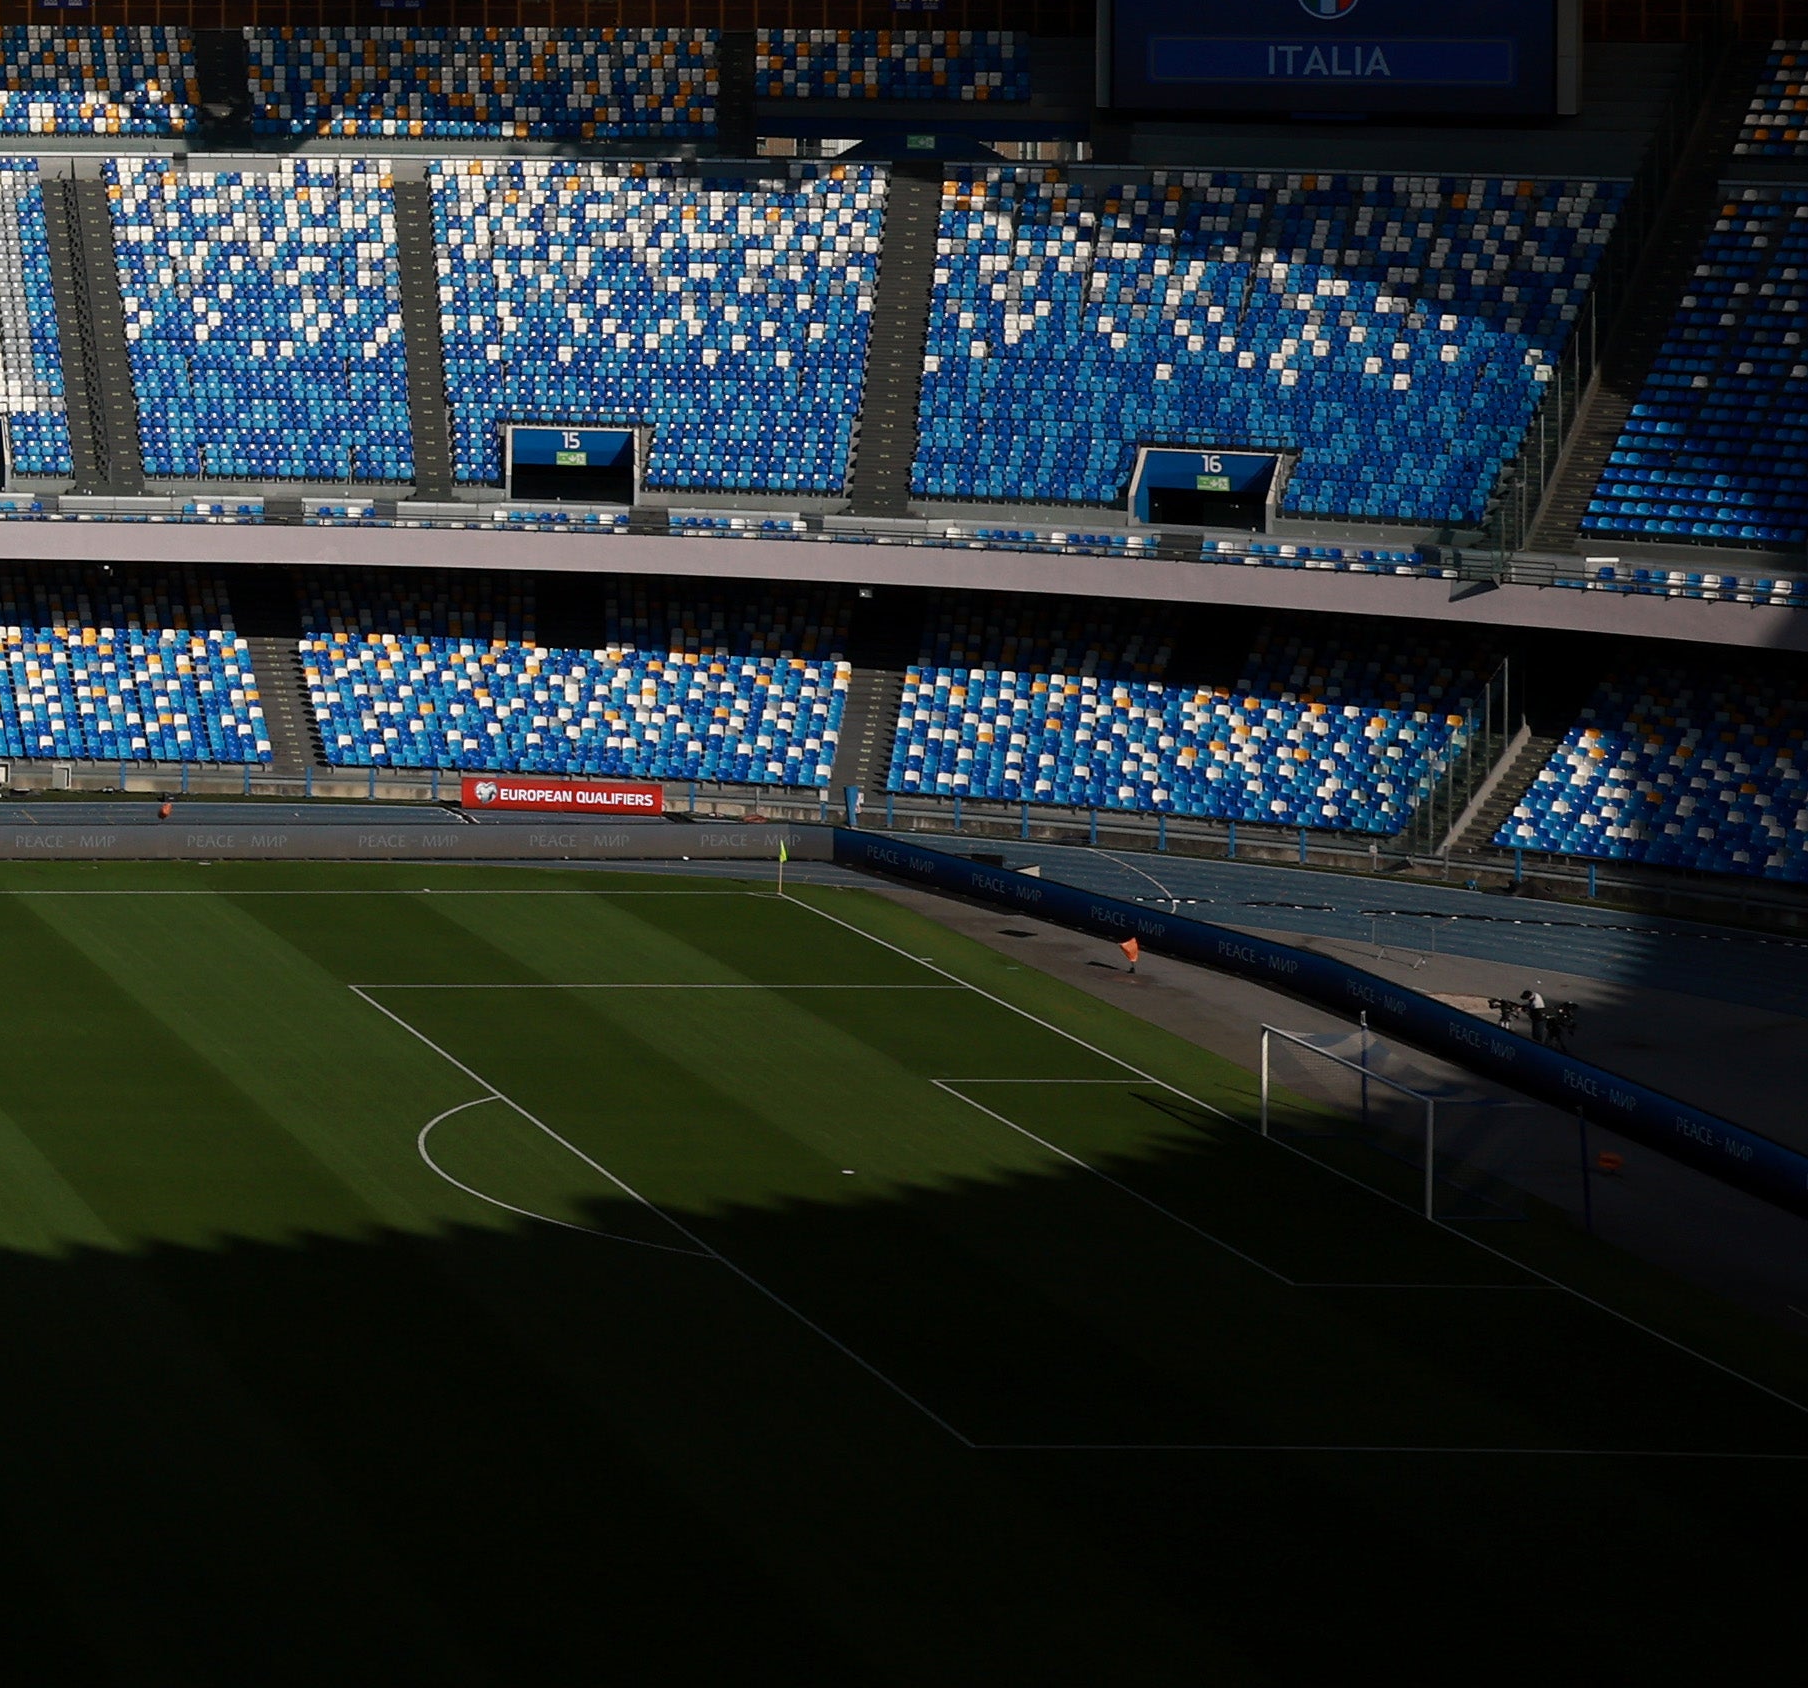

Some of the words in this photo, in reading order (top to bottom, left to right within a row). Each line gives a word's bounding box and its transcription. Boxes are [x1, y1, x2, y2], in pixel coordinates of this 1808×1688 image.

[1268, 45, 1391, 76] ITALIA
[562, 432, 581, 449] 15
[1202, 455, 1222, 473] 16
[500, 788, 573, 803] EUROPEAN
[576, 791, 654, 807] QUALIFIERS
[16, 835, 64, 848] PEACE
[187, 835, 234, 848] PEACE
[359, 835, 405, 847] PEACE
[530, 834, 577, 847] PEACE
[701, 834, 747, 847] PEACE
[867, 844, 899, 865] PEACE
[971, 872, 1005, 895] PEACE
[1090, 905, 1126, 927] PEACE
[1218, 941, 1256, 964] PEACE
[1347, 979, 1375, 1004] PEACE
[1448, 1022, 1483, 1048] PEACE
[1563, 1069, 1598, 1097] PEACE
[1676, 1116, 1713, 1146] PEACE
